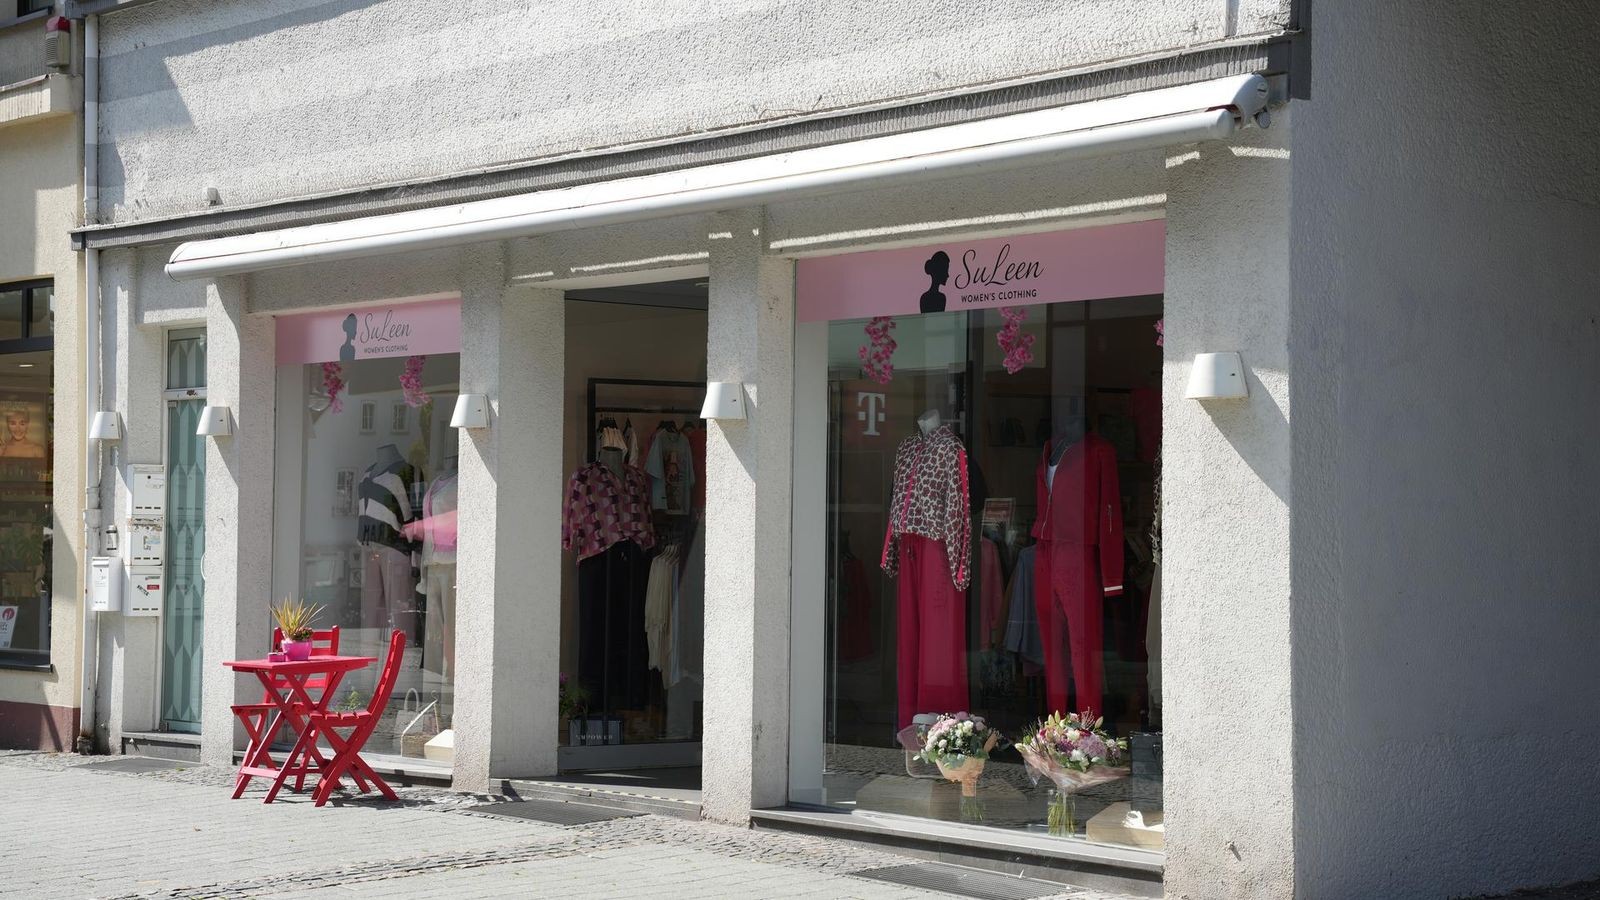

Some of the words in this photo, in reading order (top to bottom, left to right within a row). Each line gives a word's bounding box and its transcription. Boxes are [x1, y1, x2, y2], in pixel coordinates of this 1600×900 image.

[955, 243, 1045, 289] SuLeen
[961, 292, 996, 303] WOMEN'S
[998, 289, 1037, 301] CLOTHING
[360, 309, 412, 344] SuLeen
[364, 345, 384, 354] WOMEN'S
[385, 343, 409, 353] CLOTHING
[858, 391, 885, 436] T
